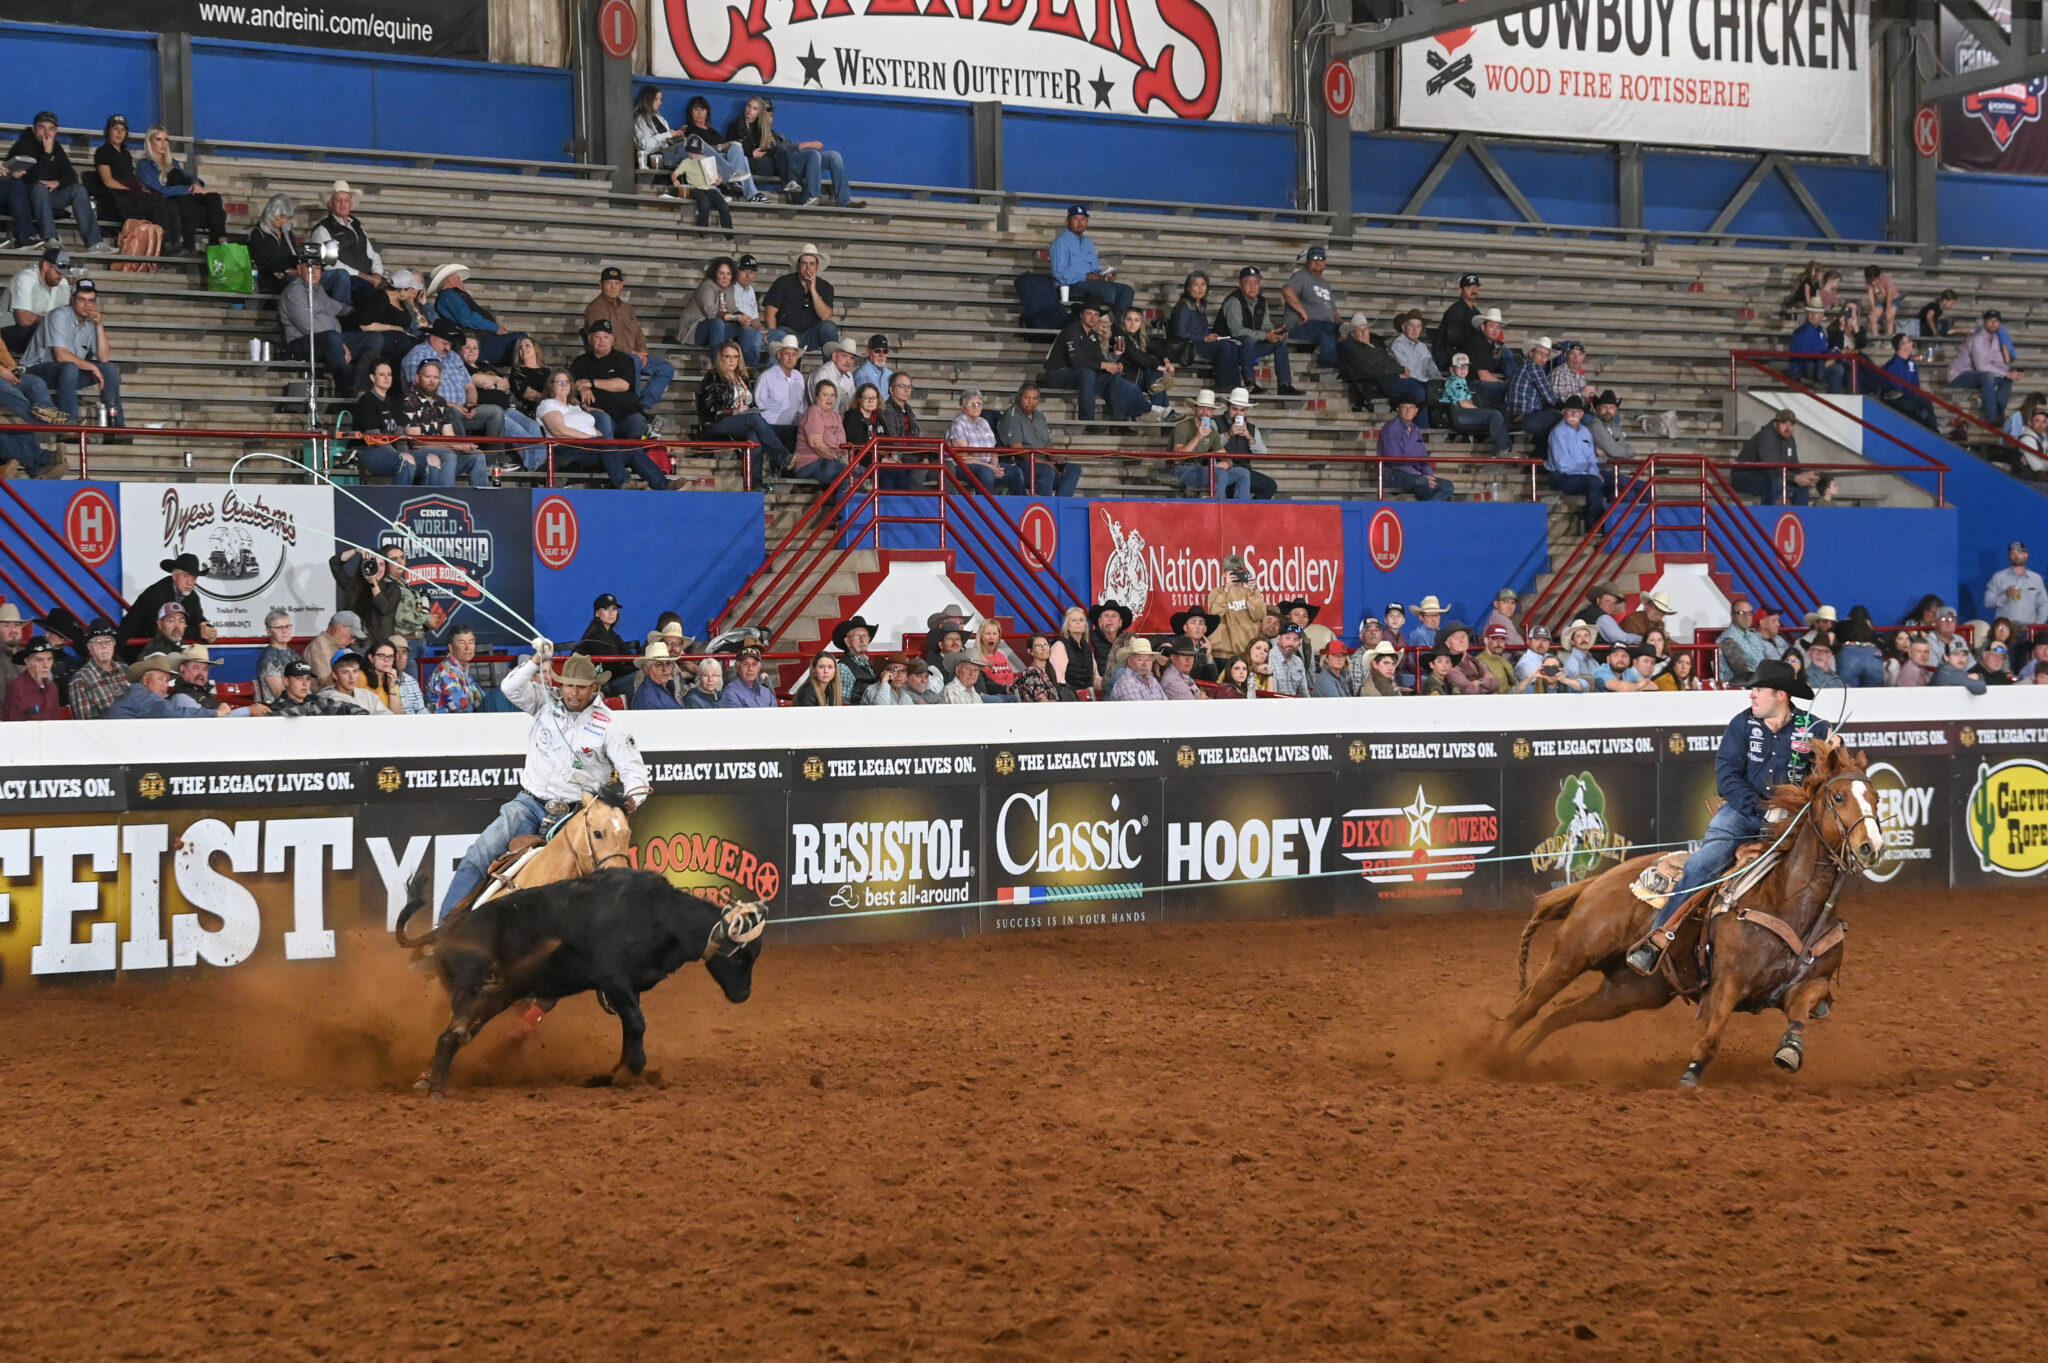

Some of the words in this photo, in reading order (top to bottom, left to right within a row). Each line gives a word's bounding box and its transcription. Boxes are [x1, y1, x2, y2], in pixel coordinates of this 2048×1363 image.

[199, 3, 433, 44] www.andreini.com/equine
[1688, 0, 1858, 71] CHICKEN
[833, 47, 946, 91] WESTERN
[953, 59, 1083, 105] OUTFITTER
[1485, 64, 1551, 94] WOOD
[1559, 70, 1612, 99] FIRE
[1619, 74, 1750, 108] ROTISSERIE
[1333, 73, 1345, 103] J
[1920, 117, 1934, 146] K
[81, 506, 103, 541] H
[162, 488, 214, 552] Dyess
[222, 489, 296, 546] Customs
[420, 509, 448, 517] CINCH
[413, 519, 457, 534] WORLD
[546, 513, 566, 546] H
[81, 544, 96, 552] SEAT
[99, 544, 104, 552] 1
[1784, 525, 1795, 553] J
[545, 548, 558, 556] SEAT
[407, 567, 437, 582] JUNIOR
[1149, 546, 1237, 592] Nation
[1243, 545, 1338, 605] Saddlery
[1532, 741, 1556, 756] THE
[1557, 739, 1601, 755] LEGACY
[1602, 738, 1634, 754] LIVES
[1635, 737, 1655, 752] ON.
[1687, 736, 1711, 751] THE
[1841, 732, 1857, 747] HE
[1858, 731, 1898, 747] LEGACY
[1899, 730, 1929, 745] LIVES
[1929, 730, 1948, 744] ON.
[1976, 729, 1998, 744] THE
[1998, 728, 2037, 743] LEGACY
[1018, 754, 1045, 771] THE
[1047, 752, 1098, 770] LEGACY
[1100, 751, 1136, 768] LIVES
[1138, 750, 1159, 767] ON.
[1198, 748, 1223, 764] THE
[1225, 747, 1273, 764] LEGACY
[1275, 746, 1310, 762] LIVES
[1312, 745, 1333, 761] ON.
[1369, 744, 1394, 759] THE
[1395, 743, 1441, 759] LEGACY
[1443, 743, 1476, 758] LIVES
[1477, 742, 1498, 758] ON.
[405, 770, 438, 788] THE
[440, 768, 501, 787] LEGACY
[655, 763, 712, 781] LEGACY
[715, 762, 756, 780] LIVES
[759, 761, 783, 779] ON.
[828, 760, 856, 777] THE
[858, 758, 912, 776] LEGACY
[914, 757, 952, 775] LIVES
[954, 756, 977, 774] ON.
[30, 778, 82, 799] LIVES
[84, 778, 116, 797] ON.
[169, 776, 206, 795] THE
[209, 774, 275, 794] LEGACY
[277, 773, 324, 792] LIVES
[327, 772, 355, 790] ON.
[996, 788, 1142, 875] Classic
[1342, 818, 1408, 848] DIXON
[1432, 816, 1498, 843] FLOWERS
[792, 819, 970, 885] RESISTOL
[1168, 817, 1332, 881] HOOEY
[629, 832, 757, 890] OOMER
[865, 886, 896, 906] best
[900, 881, 969, 904] all-around
[996, 916, 1042, 929] SUCCESS
[1048, 916, 1056, 926] IS
[1063, 915, 1074, 925] IN
[1079, 913, 1106, 924] YOUR
[1112, 911, 1146, 922] HANDS
